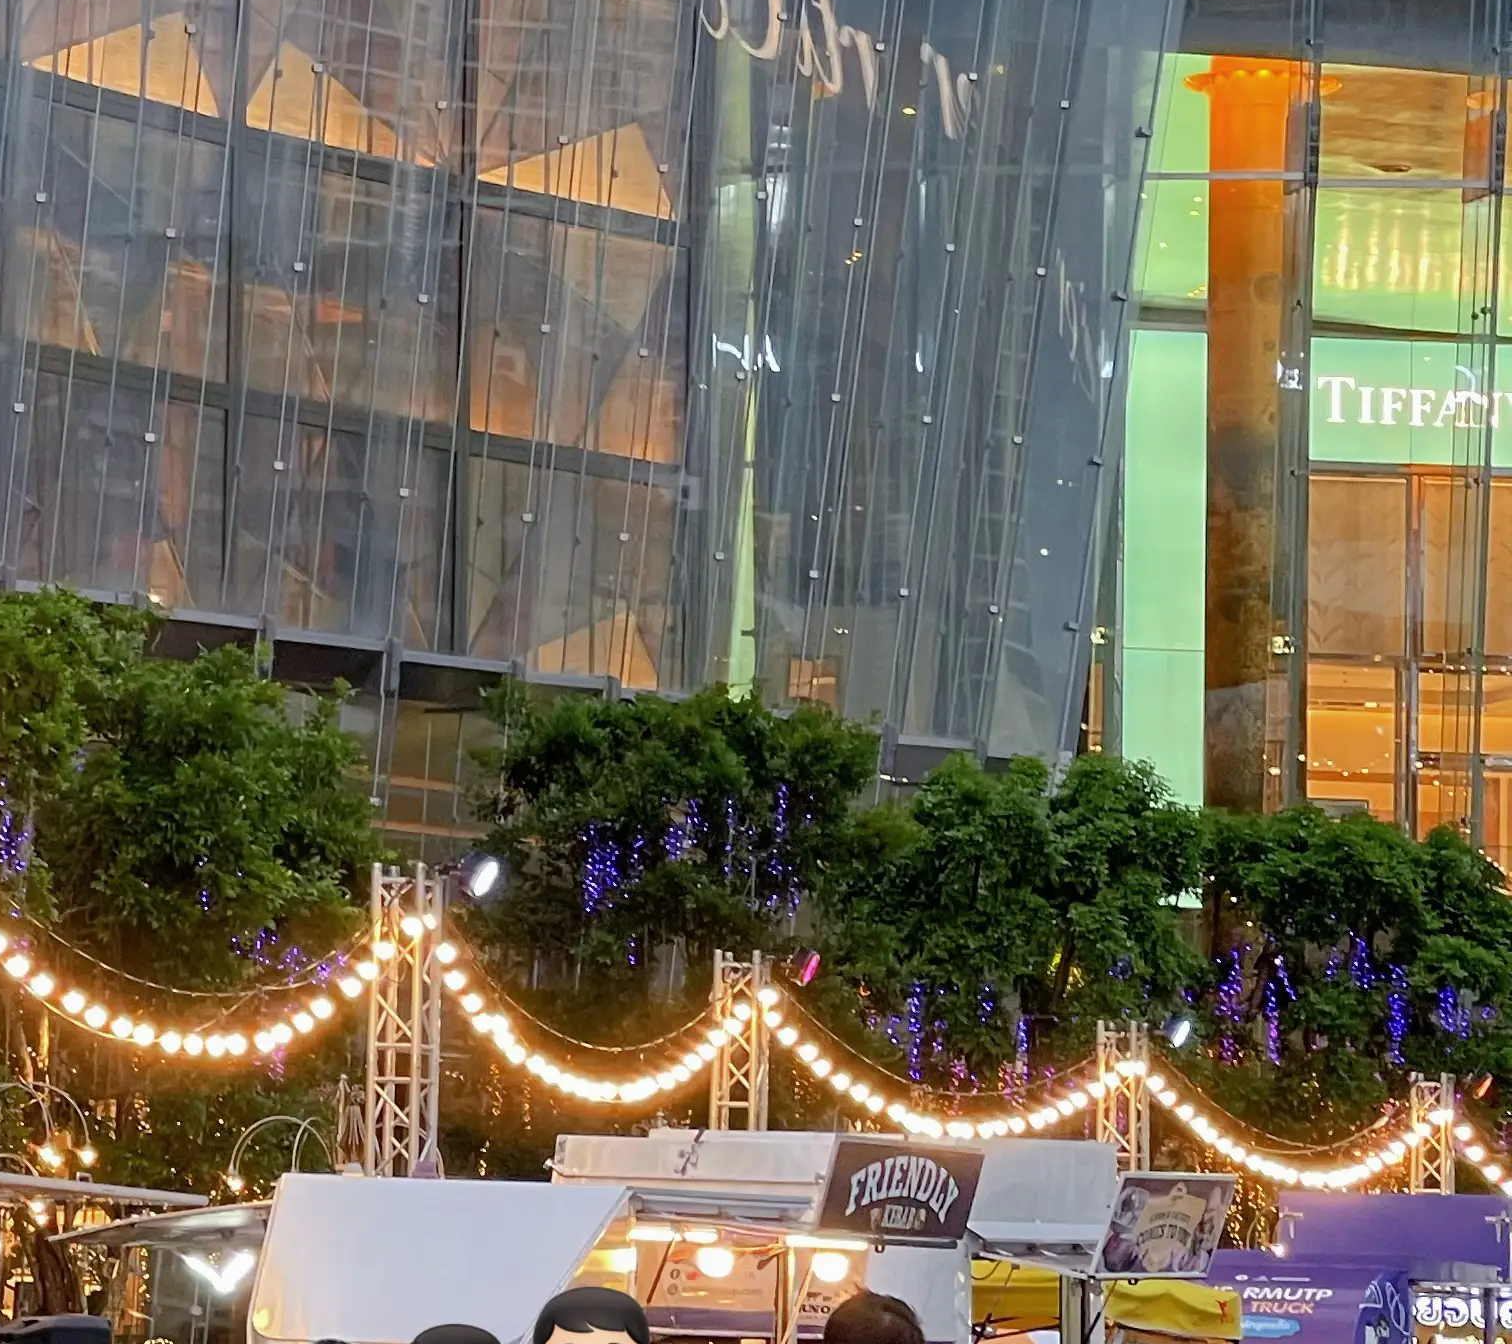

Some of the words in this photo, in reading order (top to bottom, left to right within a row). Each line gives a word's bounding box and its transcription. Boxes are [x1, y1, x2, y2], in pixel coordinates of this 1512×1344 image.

[844, 1155, 960, 1224] FRIENDLY
[1243, 1286, 1334, 1302] RMUTP
[1250, 1300, 1316, 1314] TRUCK
